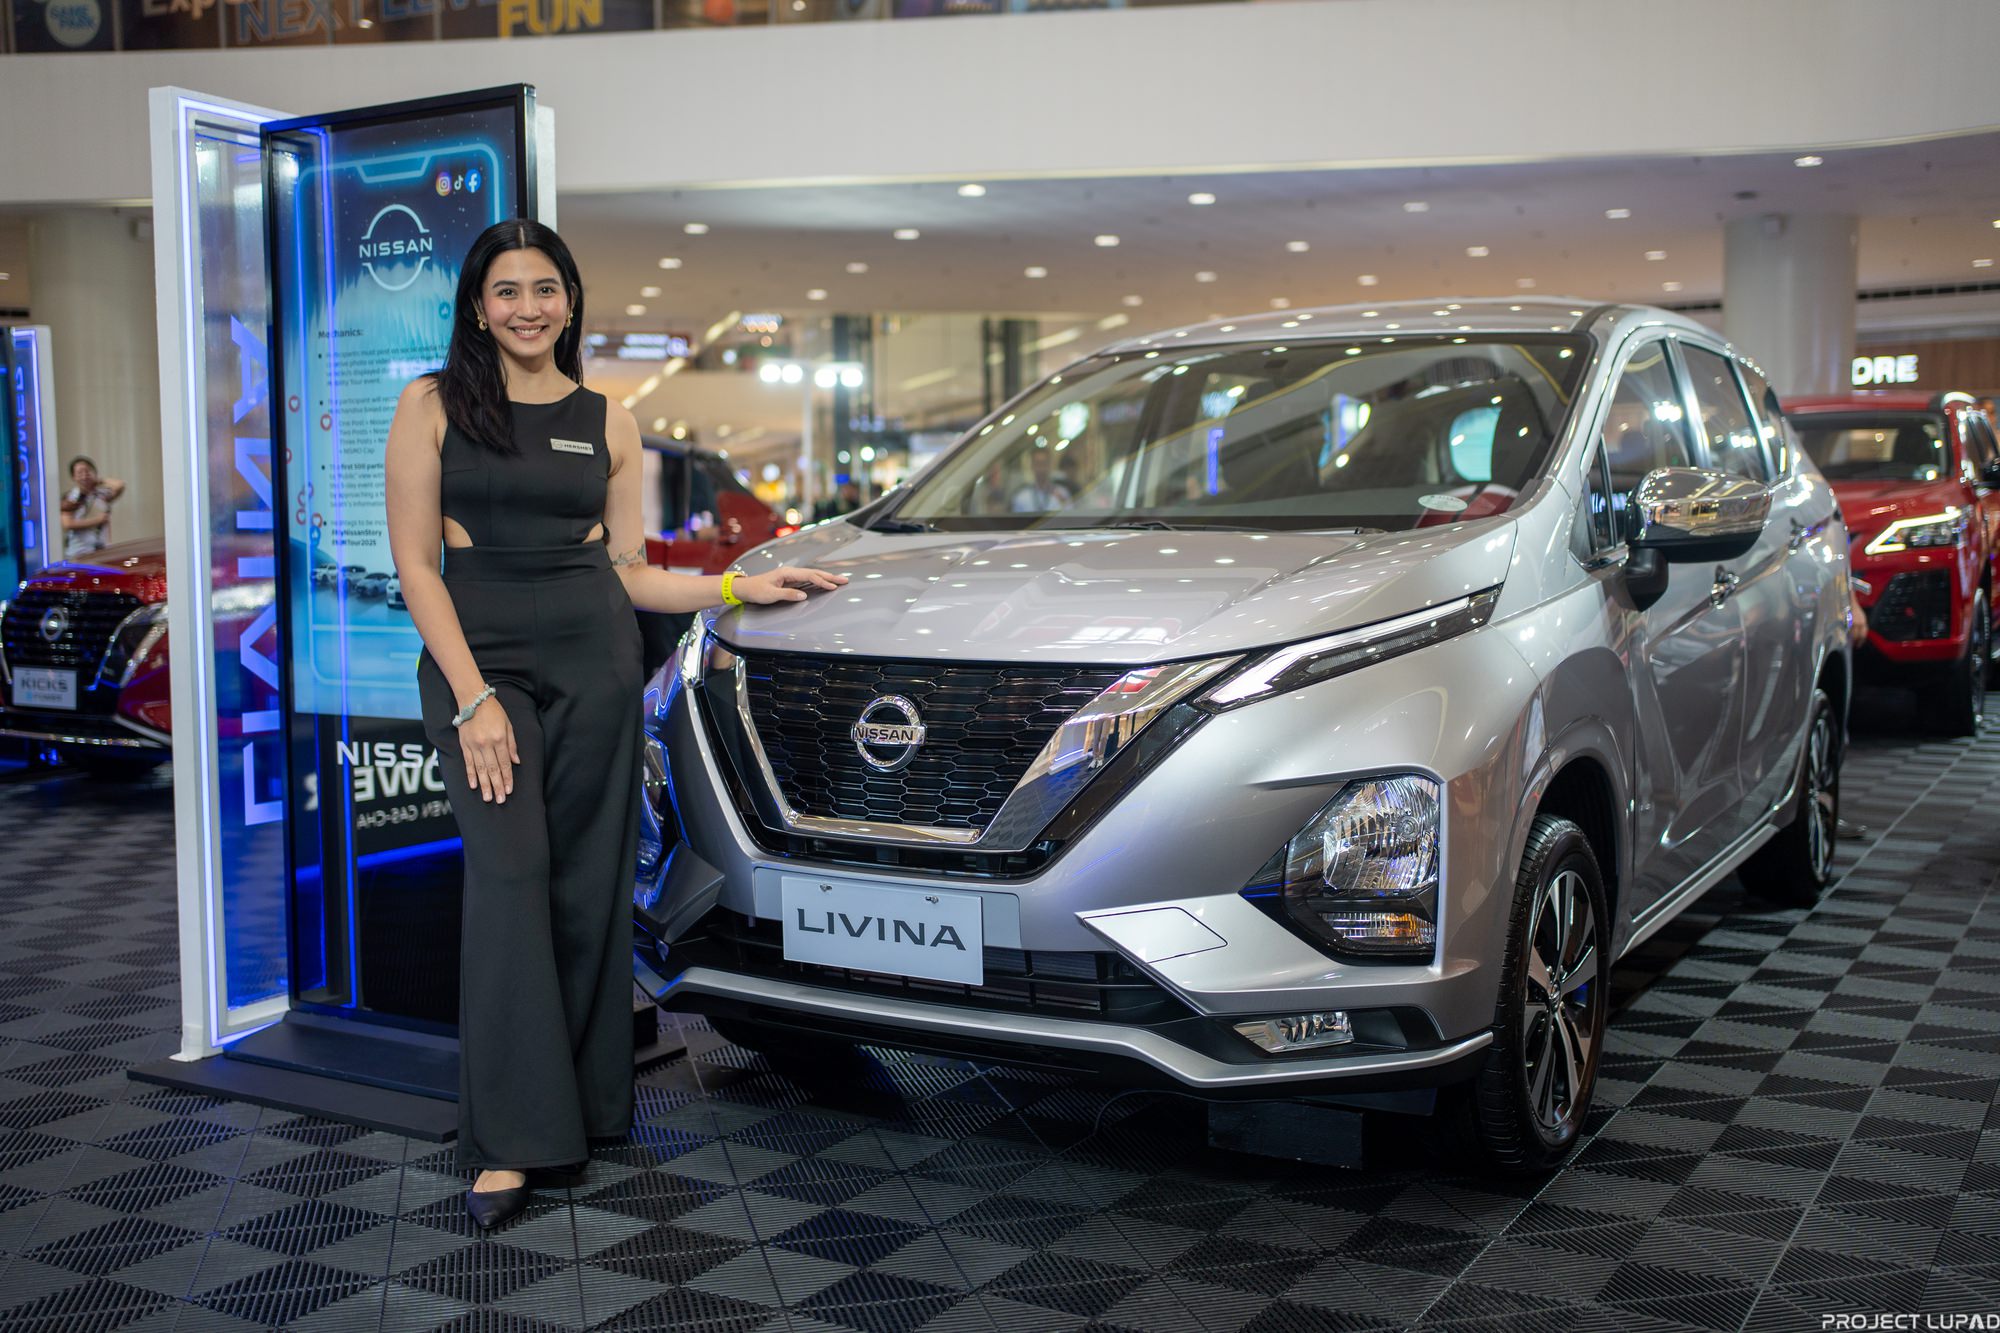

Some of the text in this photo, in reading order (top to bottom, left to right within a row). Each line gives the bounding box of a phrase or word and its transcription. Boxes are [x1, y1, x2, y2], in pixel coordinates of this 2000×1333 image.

[499, 0, 604, 40] FUN
[359, 237, 433, 258] NISSAN
[21, 677, 69, 692] KICKS
[855, 727, 914, 741] NISSAN
[797, 907, 967, 952] LIVINA
